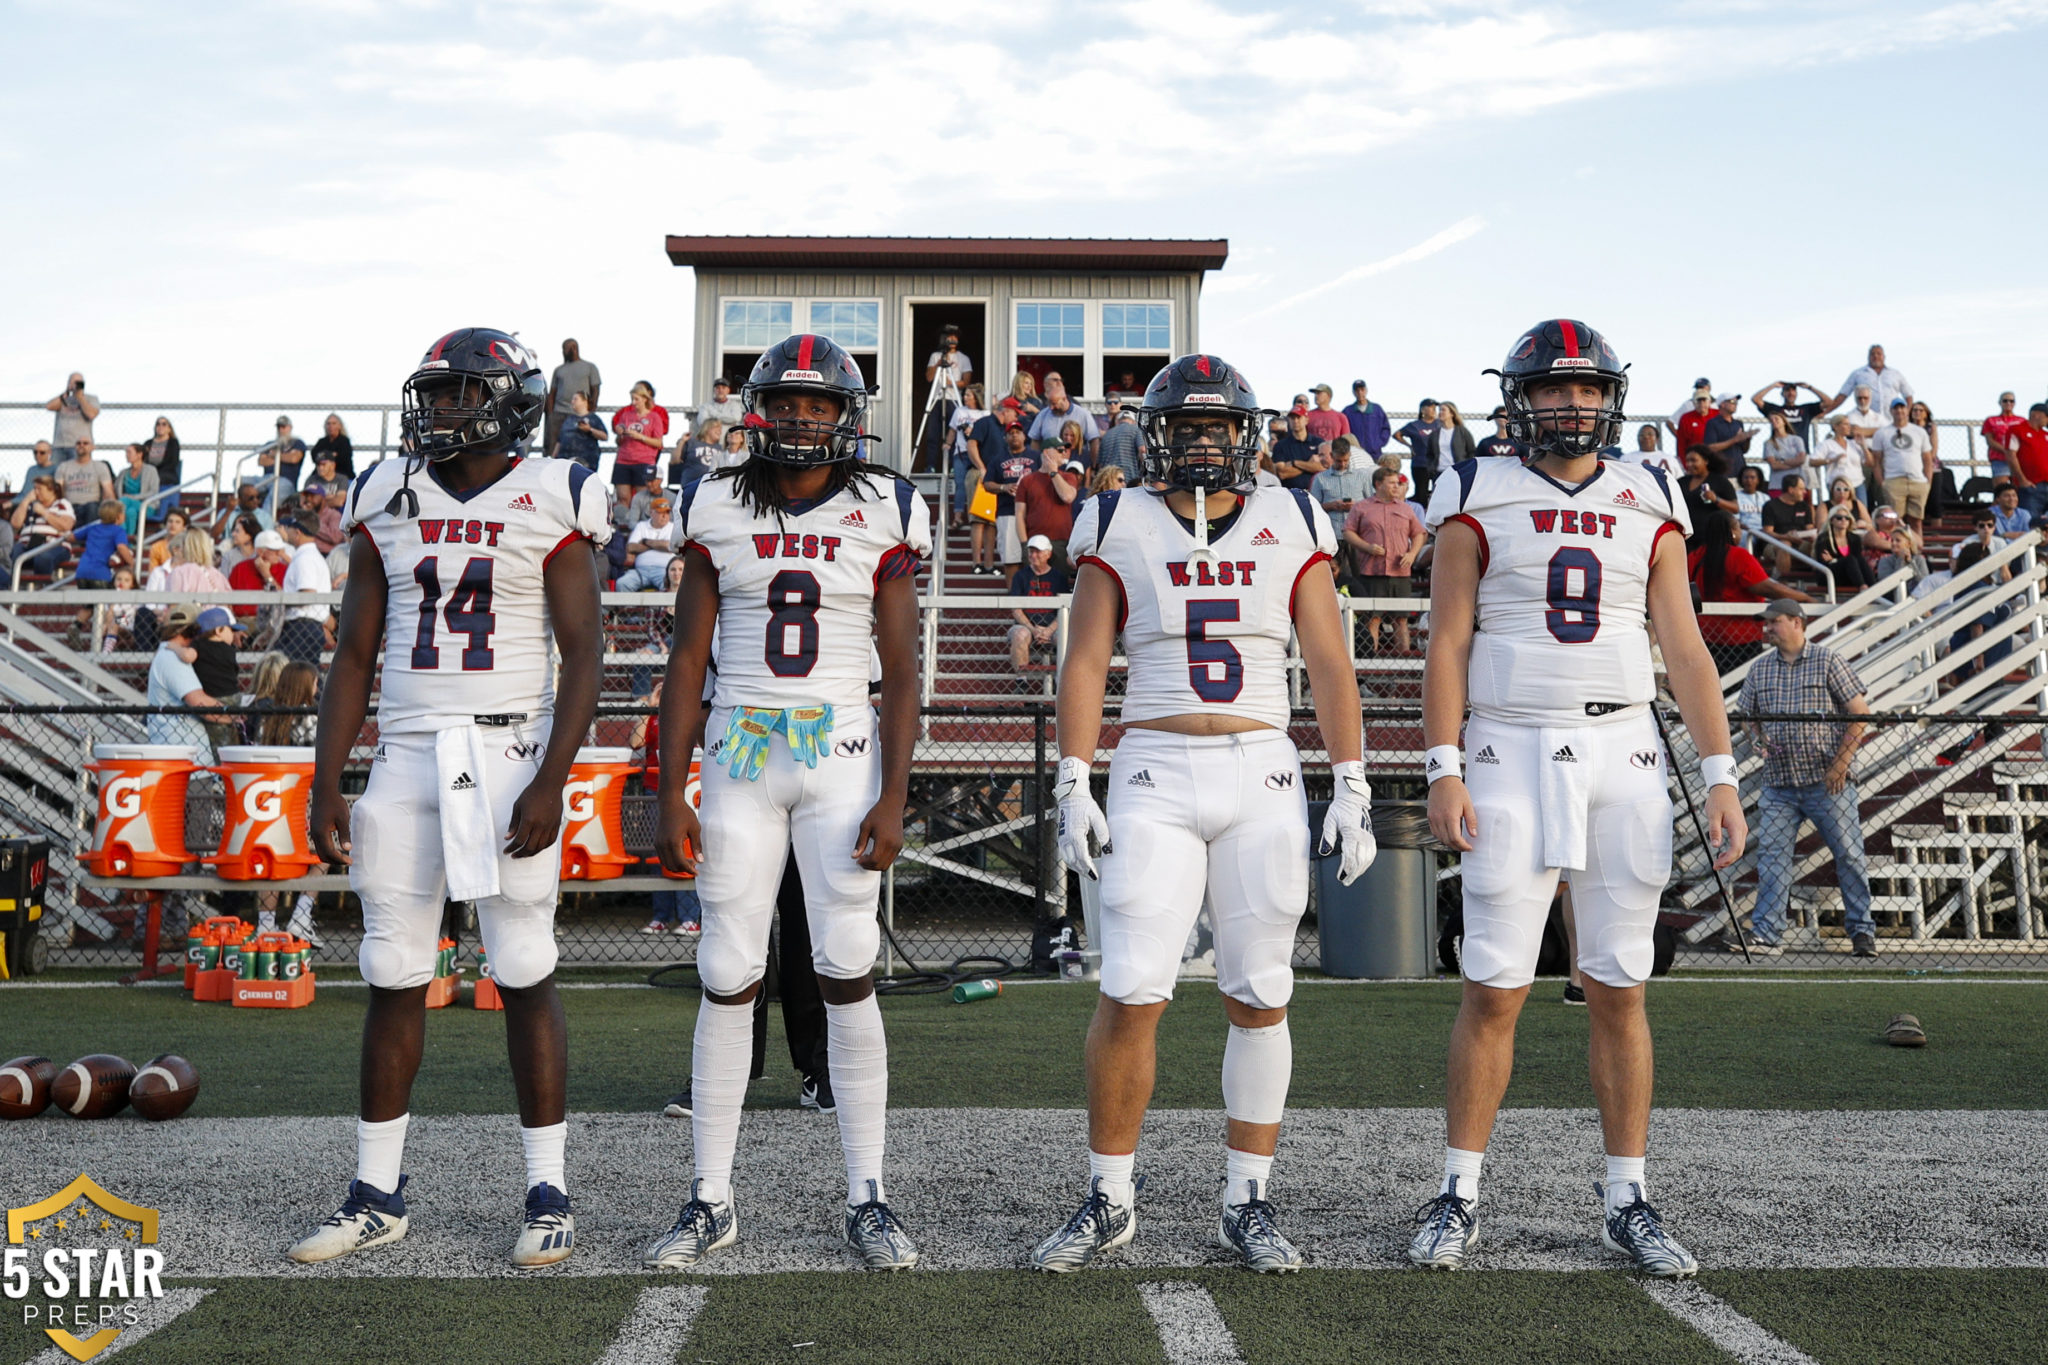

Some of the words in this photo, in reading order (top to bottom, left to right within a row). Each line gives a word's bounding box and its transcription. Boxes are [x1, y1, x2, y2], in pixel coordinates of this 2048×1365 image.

[786, 371, 819, 380] Riddell
[1188, 395, 1222, 403] Riddell
[1493, 445, 1513, 455] W
[508, 502, 537, 512] adidas
[1613, 498, 1639, 508] adidas
[839, 519, 868, 530] adidas
[1530, 509, 1617, 539] WEST
[418, 519, 505, 547] WEST
[752, 533, 842, 562] WEST
[1251, 537, 1280, 546] adidas
[1166, 561, 1256, 587] WEST
[1545, 546, 1603, 643] 9
[411, 556, 496, 671] 14
[765, 569, 822, 678] 8
[1185, 599, 1244, 703] 5
[842, 740, 867, 754] W
[1474, 756, 1500, 765] adidas
[1552, 755, 1578, 763] adidas
[1636, 752, 1657, 767] W
[451, 781, 477, 791] adidas
[1127, 779, 1156, 789] adidas
[1271, 773, 1293, 788] W
[106, 777, 141, 819] G
[244, 780, 281, 822] G
[562, 780, 595, 822] G
[225, 955, 238, 969] G
[285, 962, 298, 977] G
[274, 990, 288, 1000] 02
[355, 1225, 392, 1247] adidas
